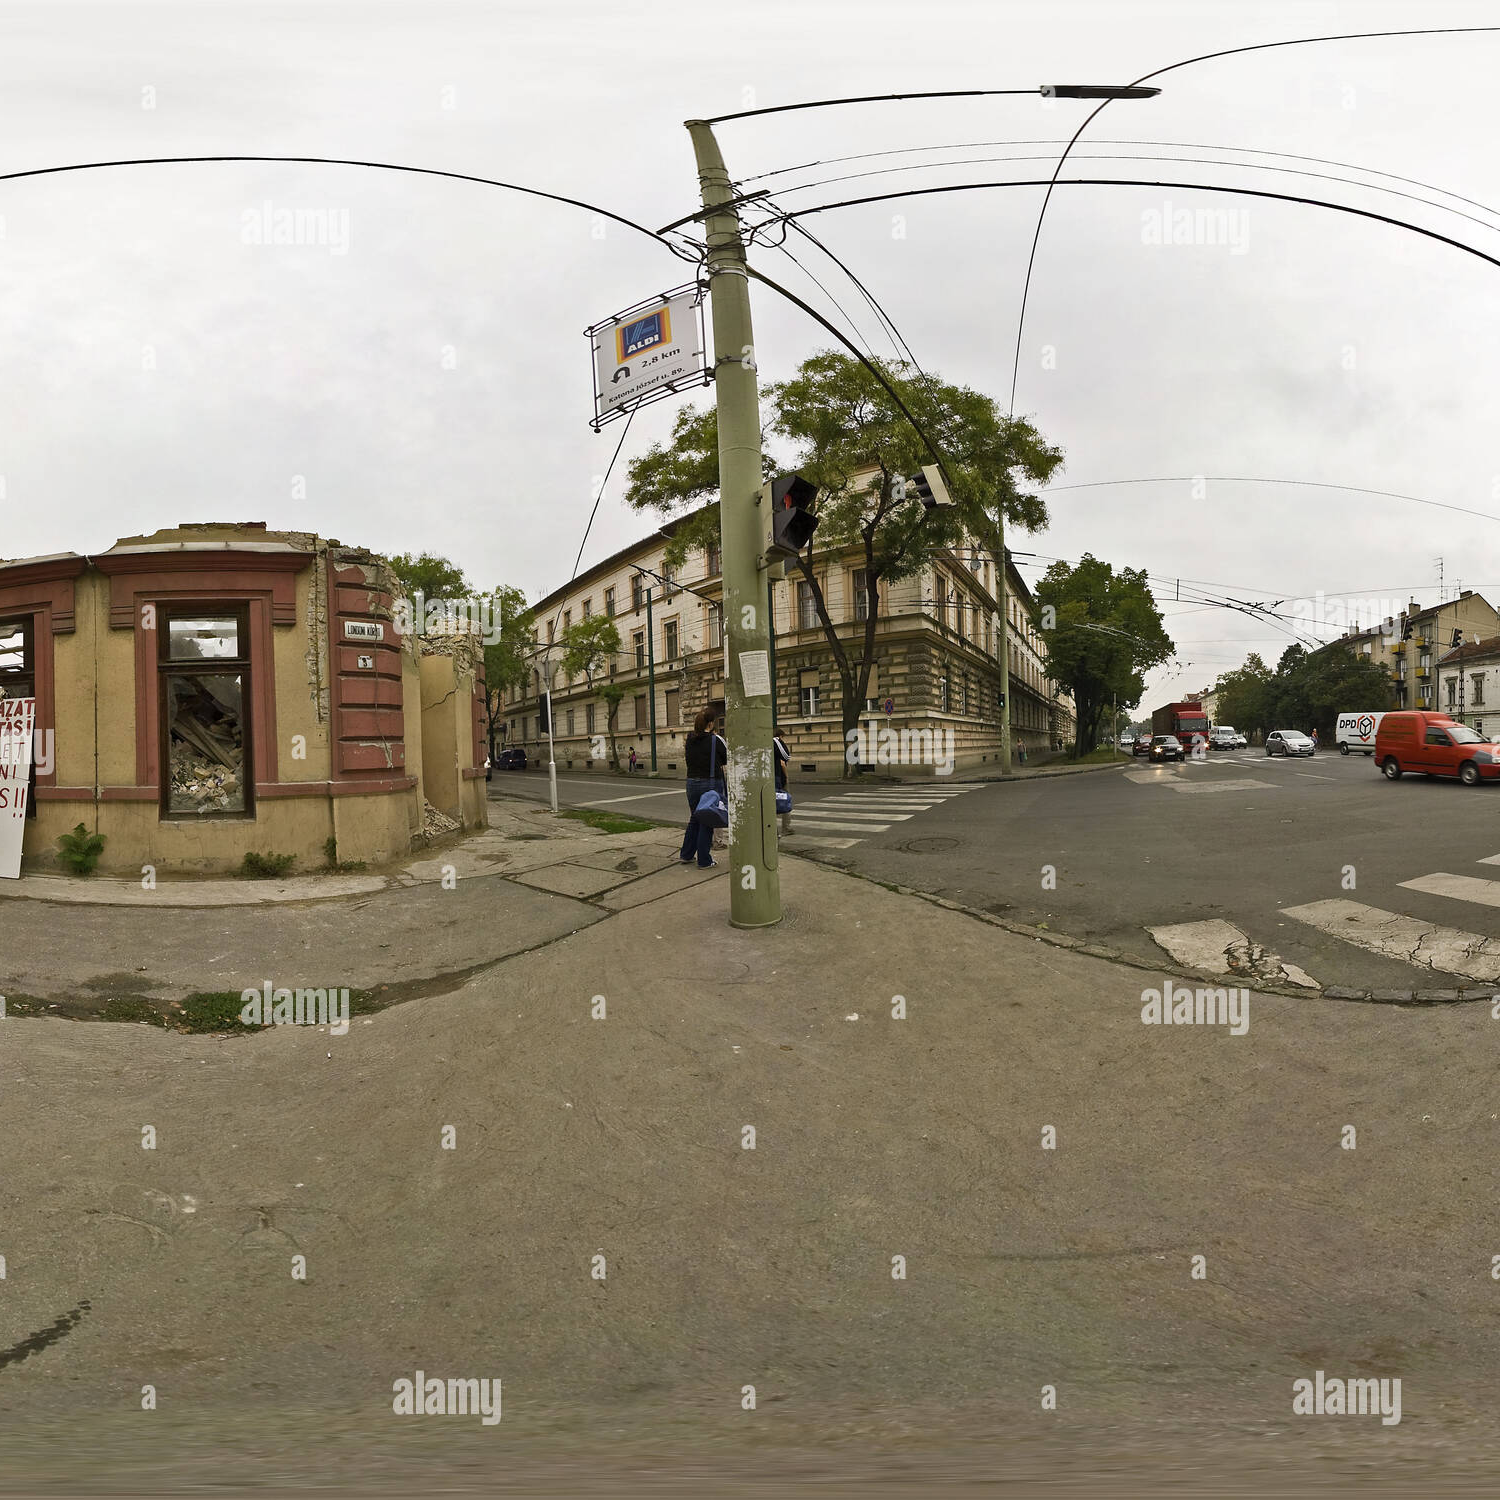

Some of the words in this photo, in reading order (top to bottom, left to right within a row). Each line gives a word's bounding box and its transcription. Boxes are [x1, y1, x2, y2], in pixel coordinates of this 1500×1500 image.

[627, 334, 659, 353] ALDI
[641, 356, 658, 368] 2,8
[661, 348, 681, 359] km
[608, 388, 635, 404] Katona
[636, 376, 659, 391] József
[1339, 720, 1357, 728] DPD
